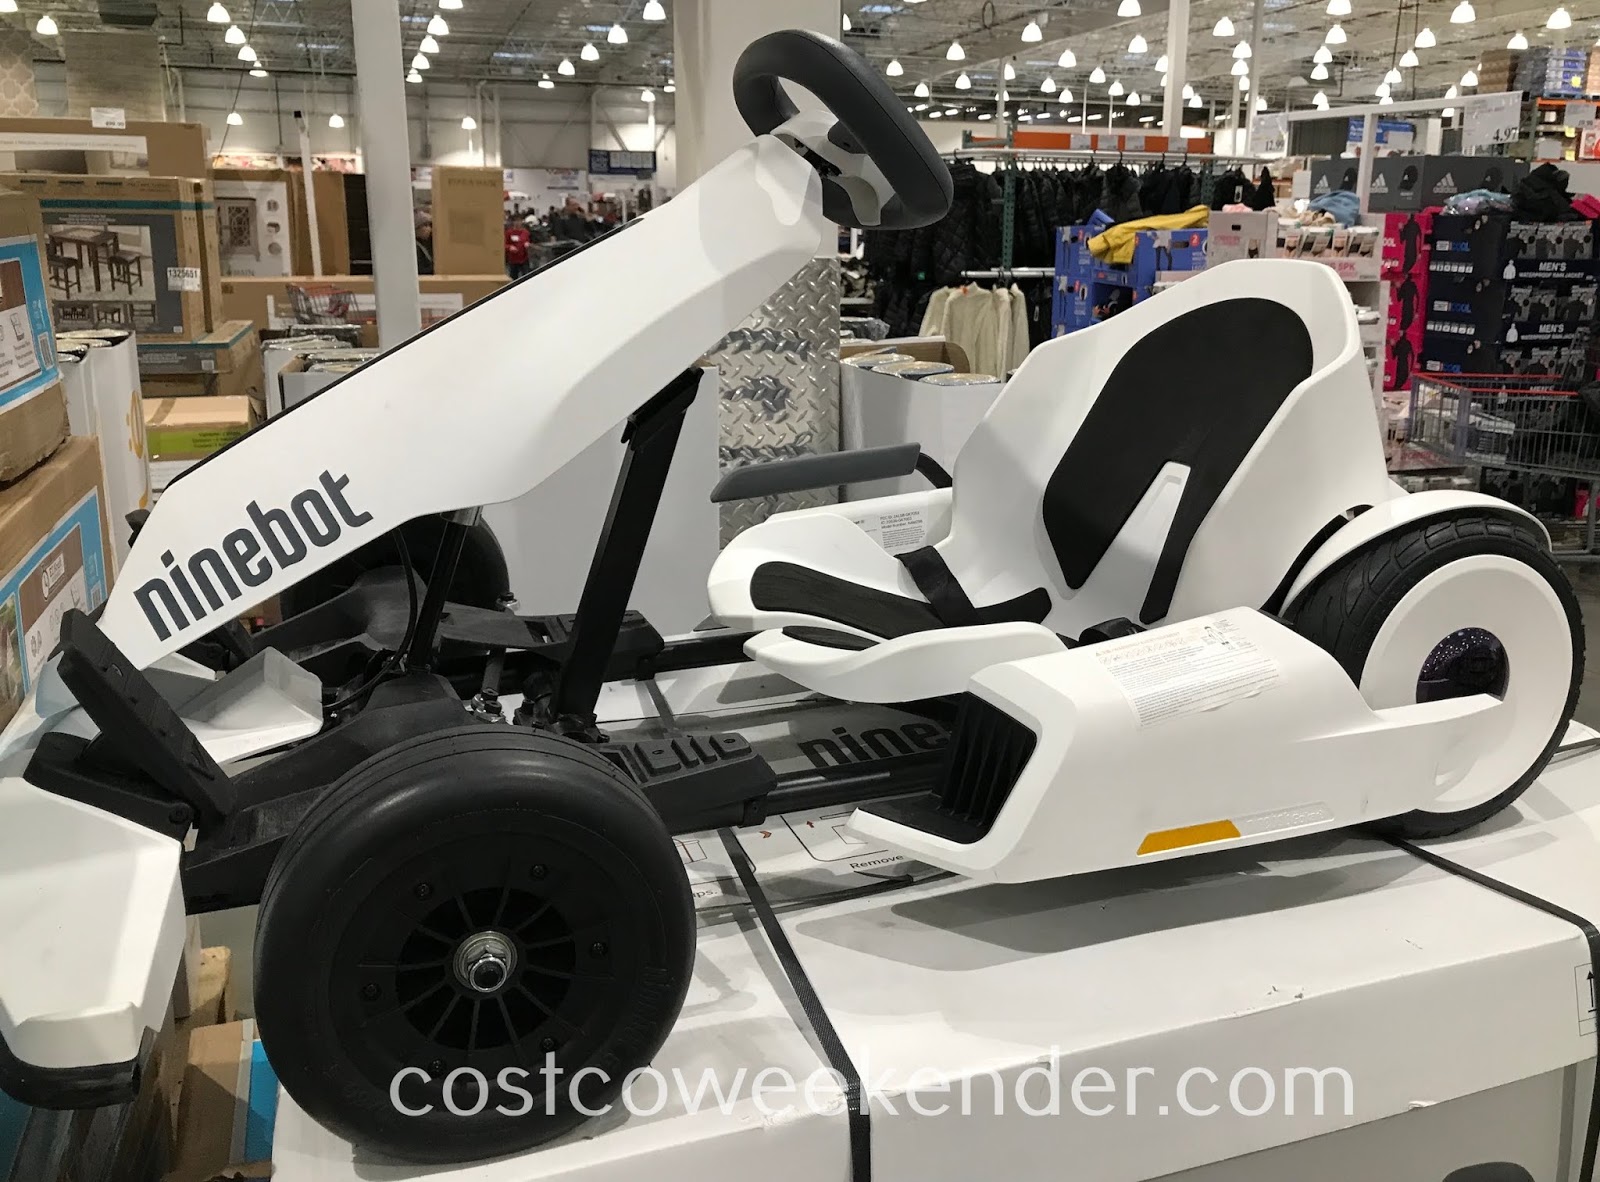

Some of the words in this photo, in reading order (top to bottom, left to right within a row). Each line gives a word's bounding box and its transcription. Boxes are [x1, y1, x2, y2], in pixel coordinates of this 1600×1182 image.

[1493, 127, 1518, 142] 4.97
[1432, 186, 1458, 194] adidas
[1538, 261, 1567, 271] MEN'S
[1538, 323, 1565, 333] MEN'S
[134, 470, 373, 642] ninebot
[798, 722, 950, 768] nine
[849, 855, 904, 869] Remove
